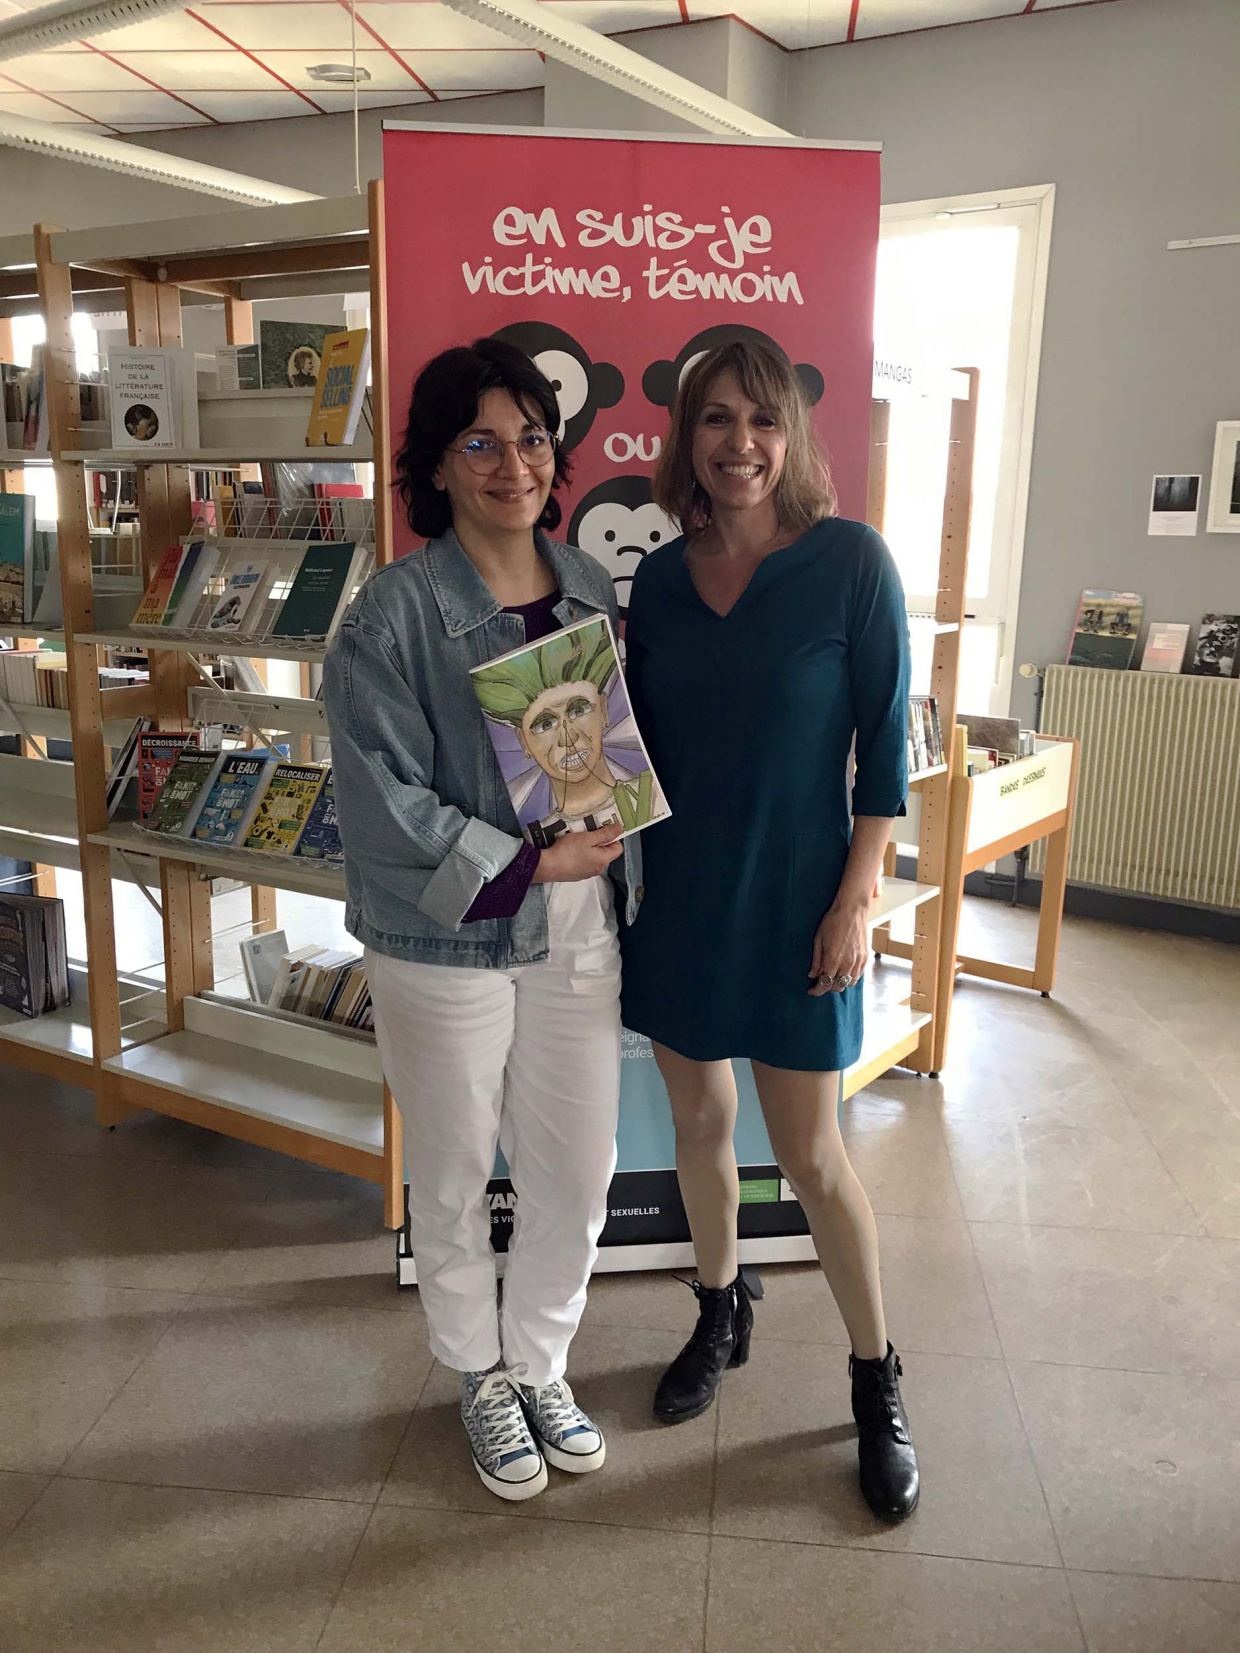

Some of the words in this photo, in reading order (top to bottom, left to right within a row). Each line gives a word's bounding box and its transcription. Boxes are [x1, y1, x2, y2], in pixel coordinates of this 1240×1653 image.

[492, 206, 566, 248] en
[576, 204, 772, 269] suis-je
[462, 252, 631, 303] victime,
[642, 256, 804, 305] témoin
[875, 361, 912, 384] MANGAS
[275, 769, 321, 782] RELOCALISER
[611, 1207, 660, 1217] SEXUELLES
